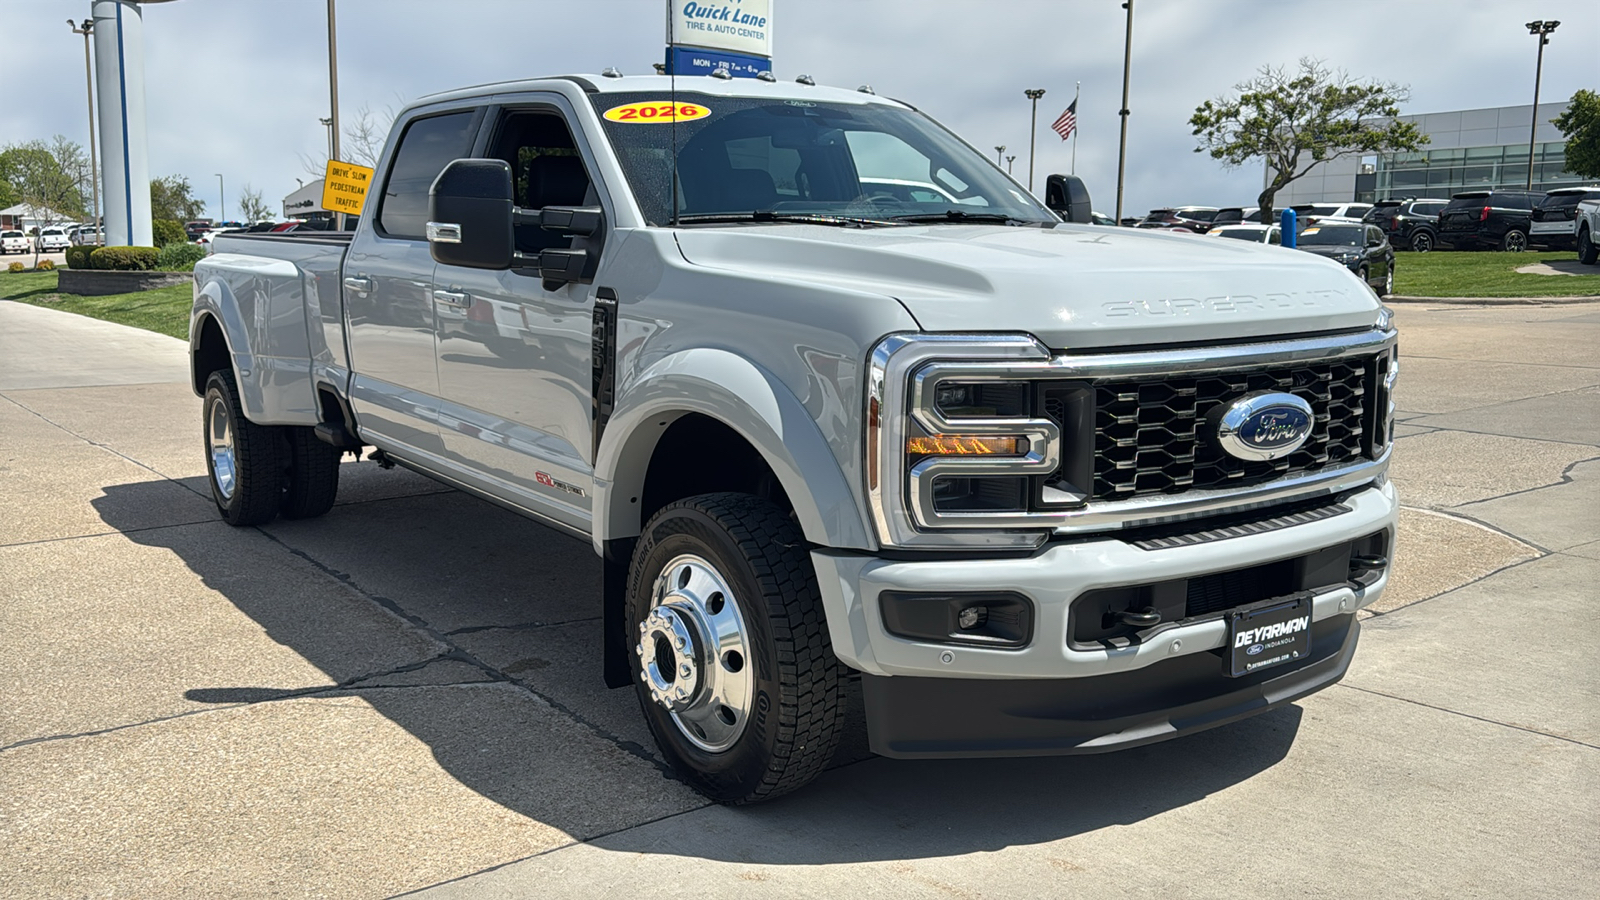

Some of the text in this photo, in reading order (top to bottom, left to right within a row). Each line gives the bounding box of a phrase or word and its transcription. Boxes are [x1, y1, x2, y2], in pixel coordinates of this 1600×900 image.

[683, 1, 767, 28] Quick Lane
[685, 21, 765, 40] TIRE & AUTO CENTER
[693, 58, 710, 67] MON
[619, 106, 699, 120] 2026
[332, 167, 366, 181] DRIVE SLOW
[330, 181, 365, 195] PEDESTRIAN
[335, 197, 358, 208] TRAFFIC
[1101, 294, 1264, 317] SUPER
[1254, 412, 1299, 443] Ford
[1234, 615, 1310, 649] DEYARMAN
[1264, 636, 1296, 649] INDIANOLA
